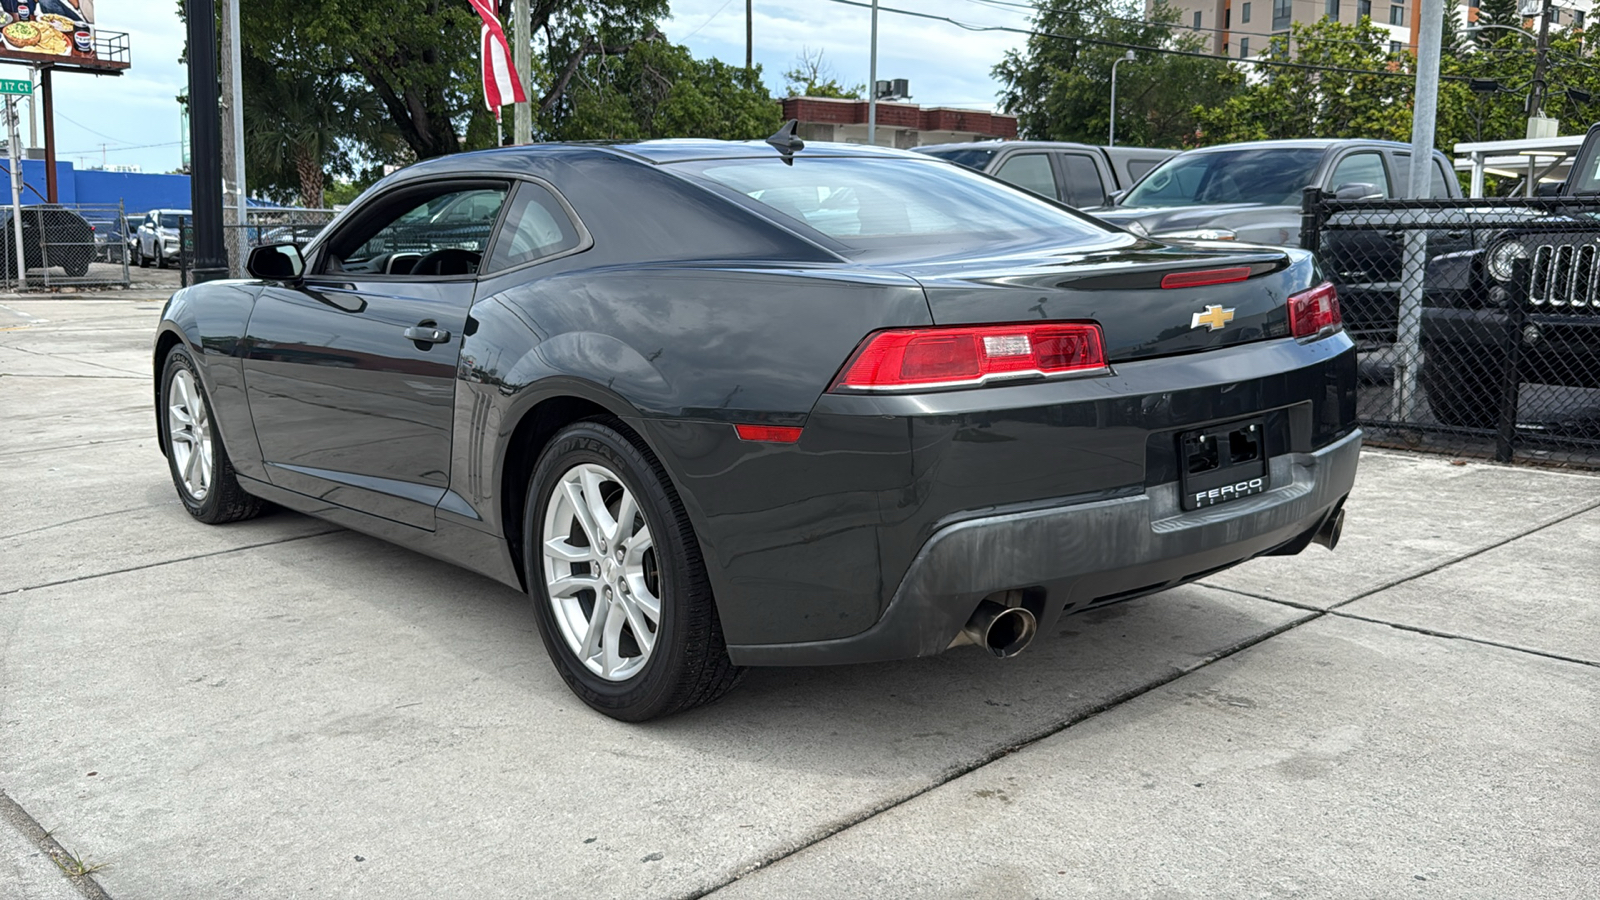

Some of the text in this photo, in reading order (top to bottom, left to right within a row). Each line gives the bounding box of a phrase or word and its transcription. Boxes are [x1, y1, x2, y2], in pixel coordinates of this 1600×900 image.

[4, 82, 15, 91] 17
[17, 82, 28, 92] Ct
[1196, 478, 1262, 501] FERCO
